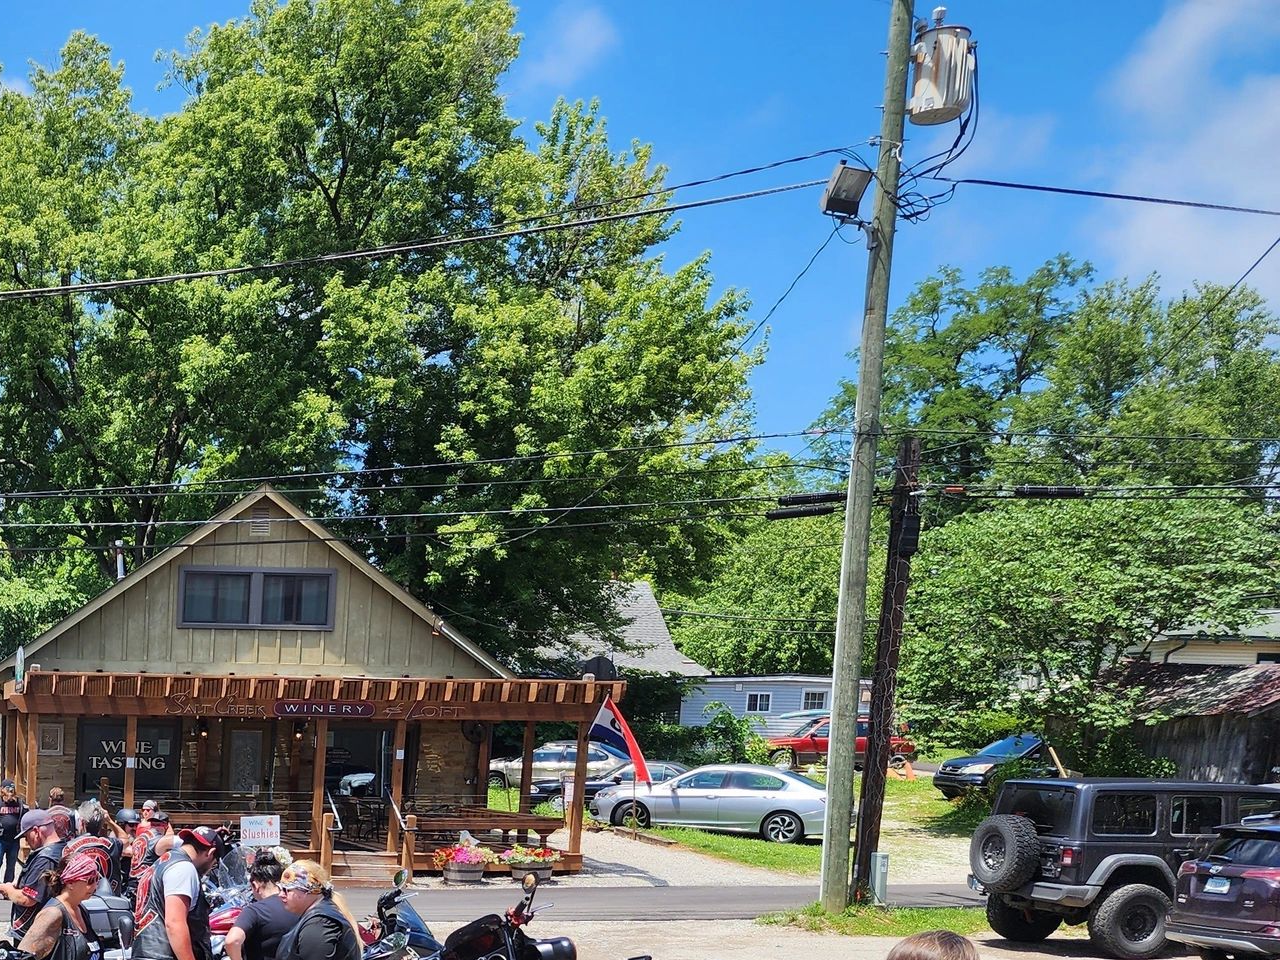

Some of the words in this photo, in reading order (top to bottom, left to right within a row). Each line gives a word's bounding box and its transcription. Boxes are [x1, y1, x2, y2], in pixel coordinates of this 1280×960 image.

[284, 704, 365, 714] WINERY
[101, 740, 152, 754] WIE
[89, 756, 166, 769] TASING
[242, 829, 279, 839] Slushies
